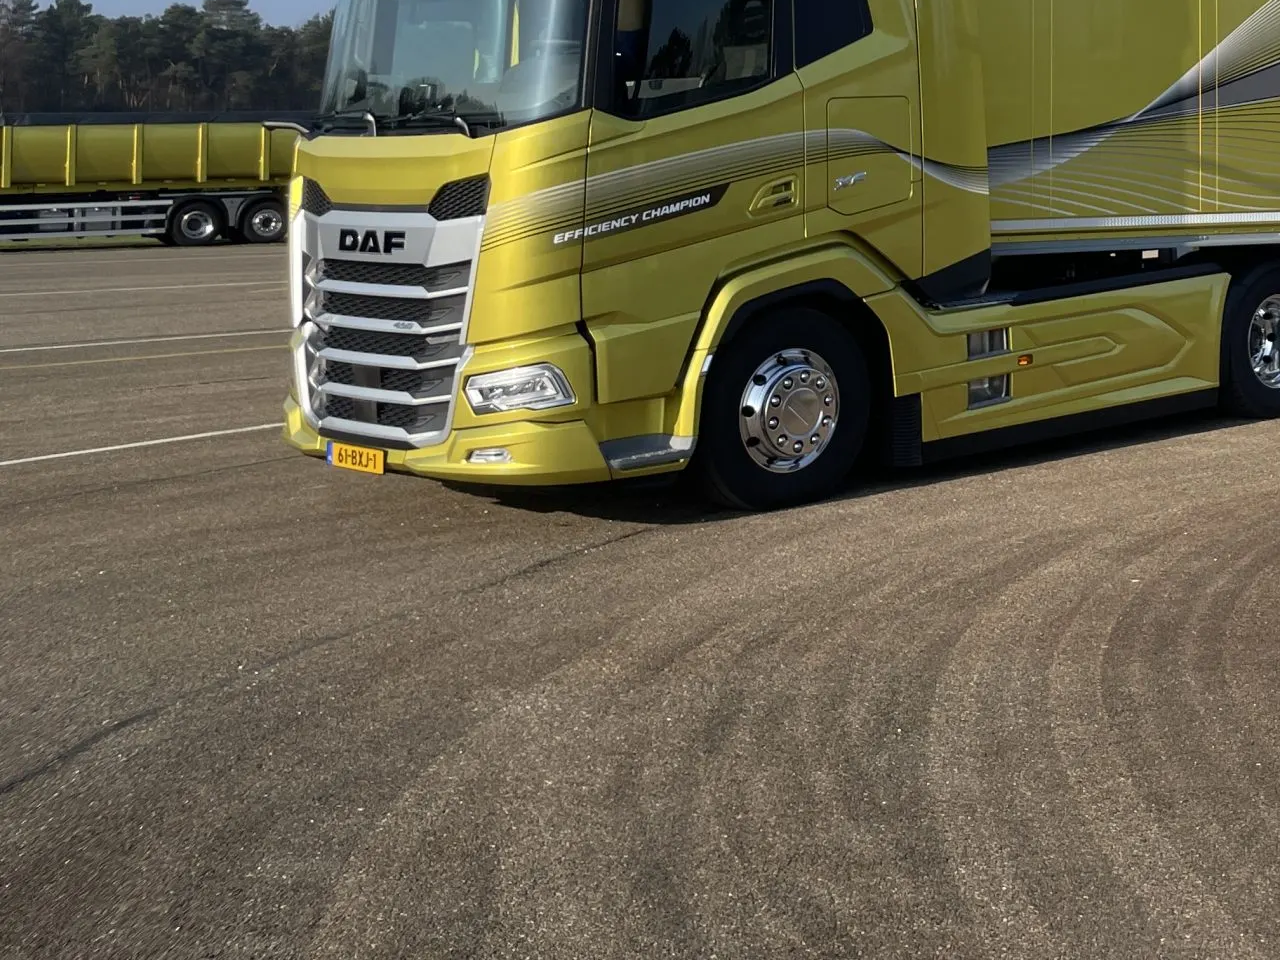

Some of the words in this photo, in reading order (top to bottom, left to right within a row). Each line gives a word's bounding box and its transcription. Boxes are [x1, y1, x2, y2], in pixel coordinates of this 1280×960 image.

[553, 214, 639, 244] EFFICIENCY
[642, 193, 711, 221] CHAMPION
[338, 228, 406, 254] DAF
